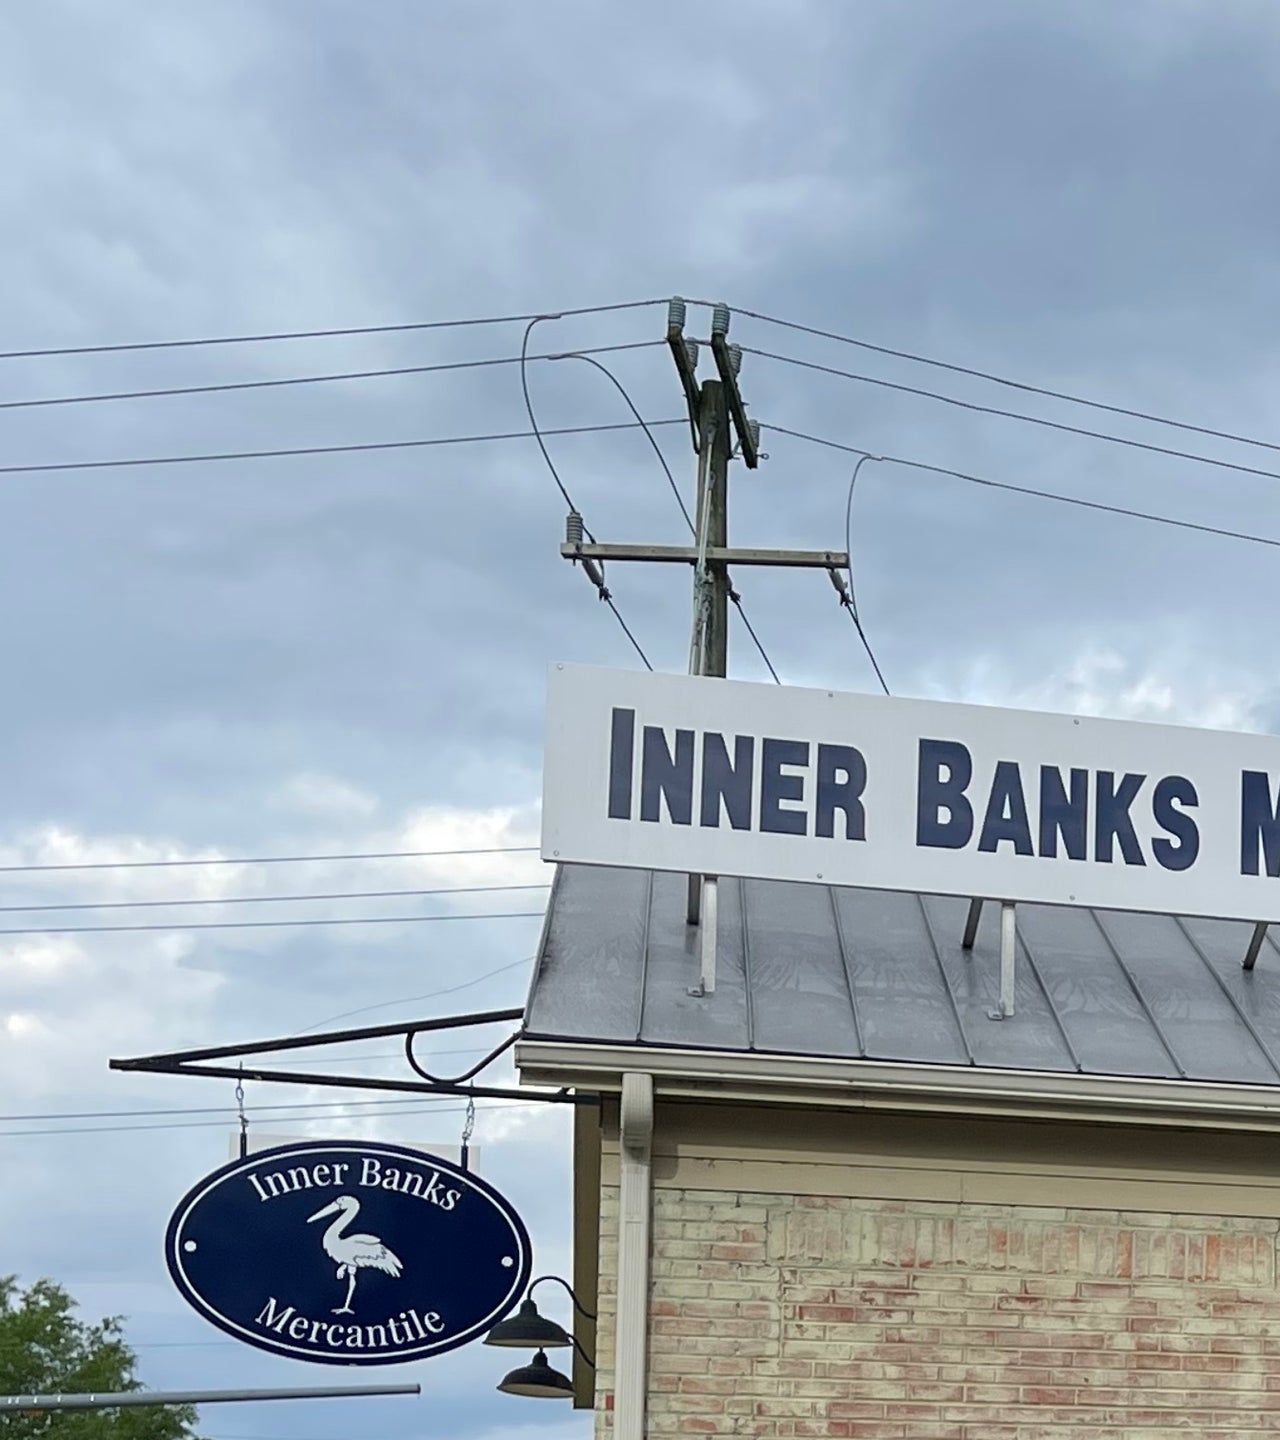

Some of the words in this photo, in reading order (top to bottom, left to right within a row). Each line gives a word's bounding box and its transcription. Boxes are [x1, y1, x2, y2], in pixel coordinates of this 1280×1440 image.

[247, 1163, 349, 1202] Inner
[359, 1158, 462, 1212] Banks
[255, 1297, 446, 1348] Mercantile
